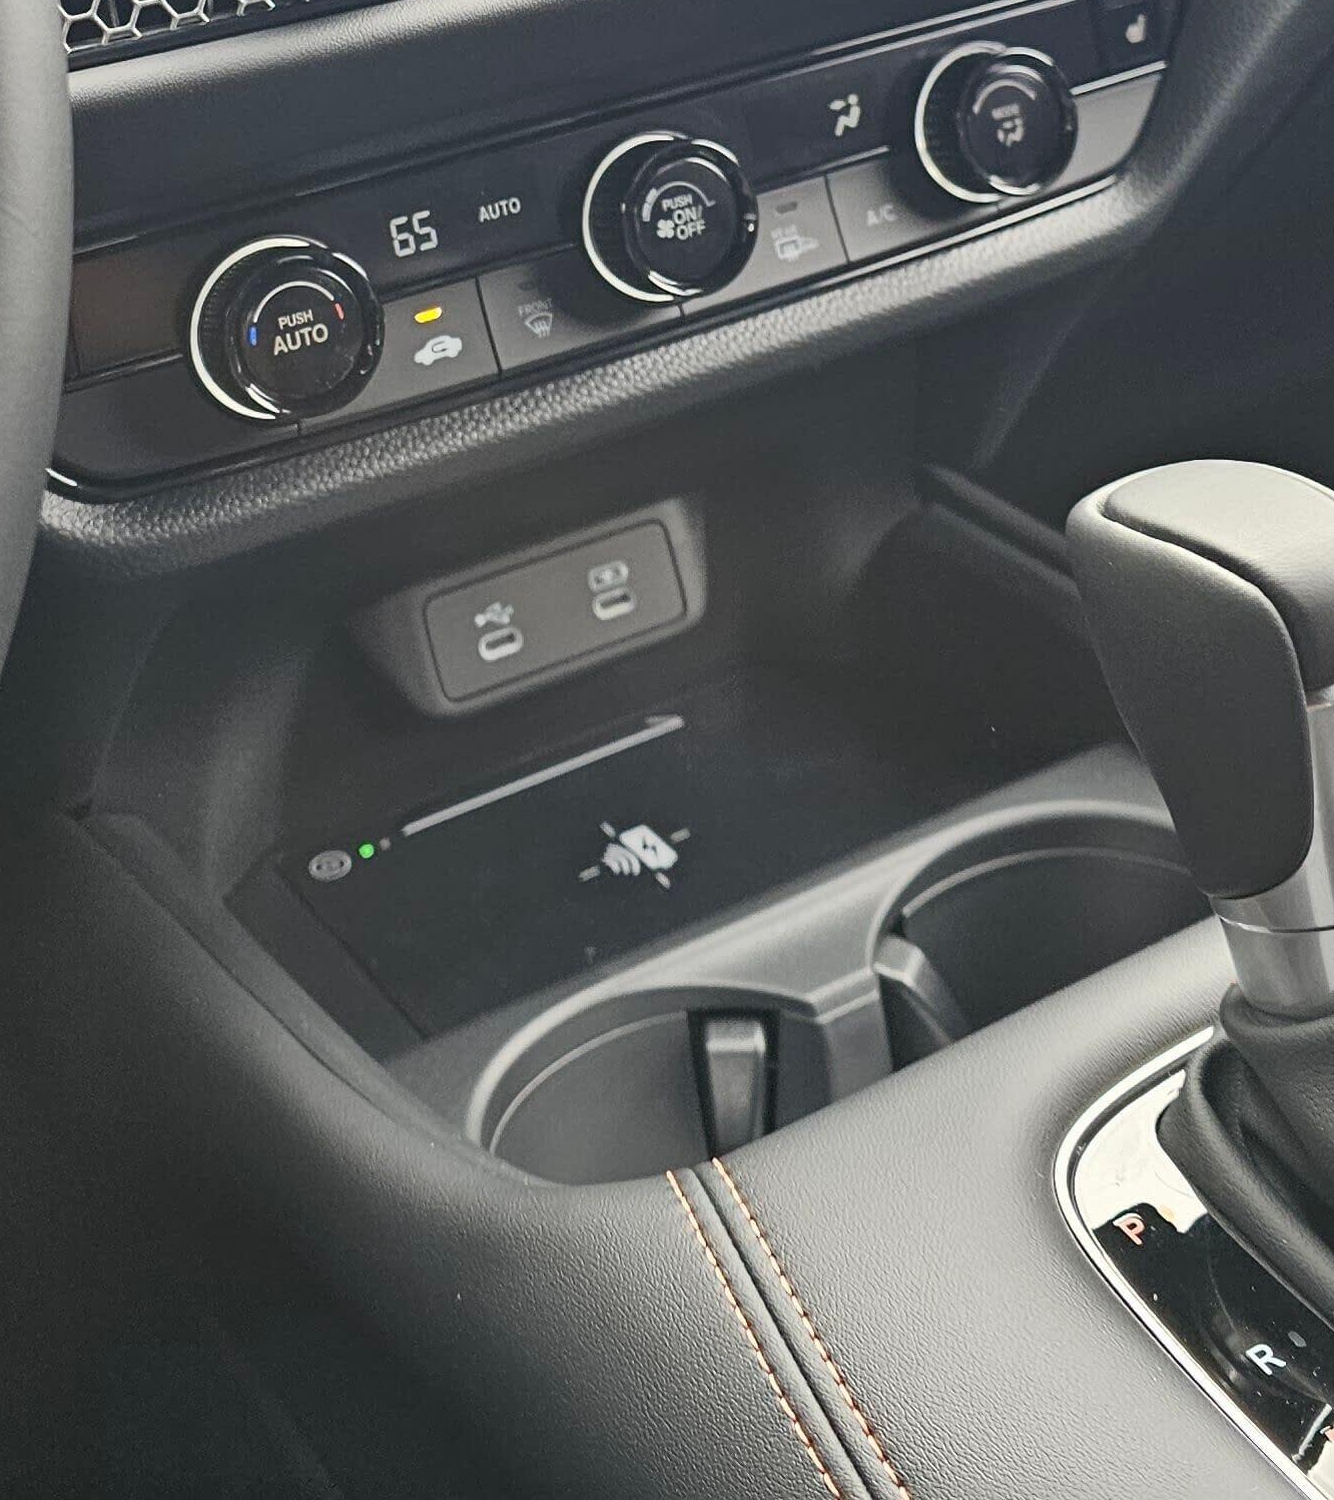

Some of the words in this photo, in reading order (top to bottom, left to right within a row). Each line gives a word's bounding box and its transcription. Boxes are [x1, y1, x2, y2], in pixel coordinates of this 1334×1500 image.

[478, 196, 521, 223] AUTO
[661, 193, 694, 212] PUSH
[867, 203, 899, 227] A/C
[388, 209, 439, 258] 65
[674, 219, 706, 241] OFF
[277, 308, 314, 330] PUSH
[273, 322, 329, 356] AUTO
[1112, 1212, 1146, 1246] P
[1245, 1343, 1287, 1376] R
